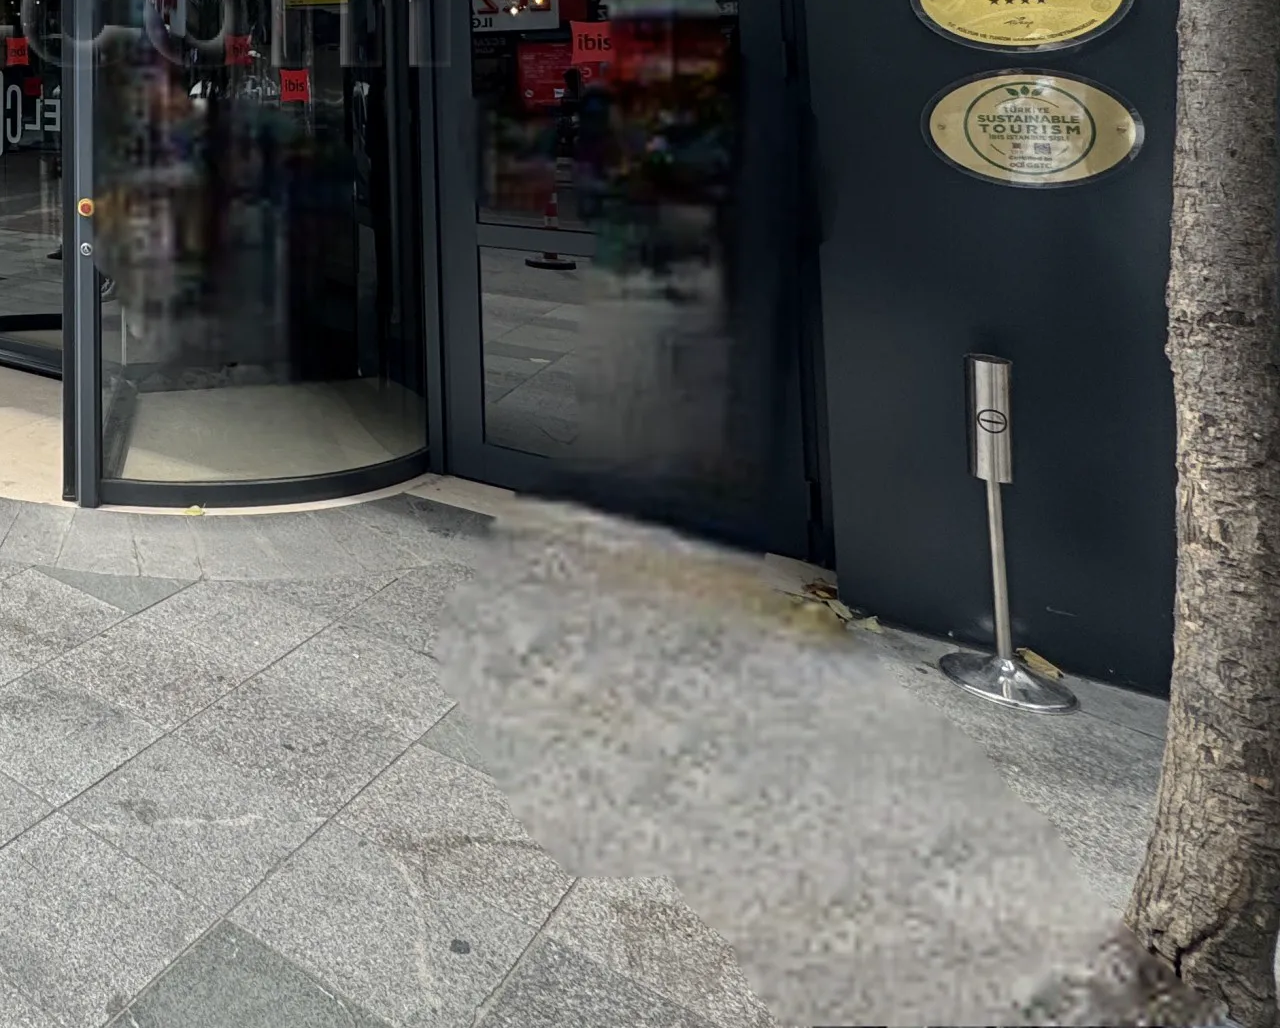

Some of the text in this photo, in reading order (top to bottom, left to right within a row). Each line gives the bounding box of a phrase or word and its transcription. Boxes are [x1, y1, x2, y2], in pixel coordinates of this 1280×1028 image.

[577, 32, 613, 53] ibis
[284, 78, 306, 93] ibis
[977, 114, 1080, 124] SUSTAINABLE
[978, 124, 1081, 135] TOURISM
